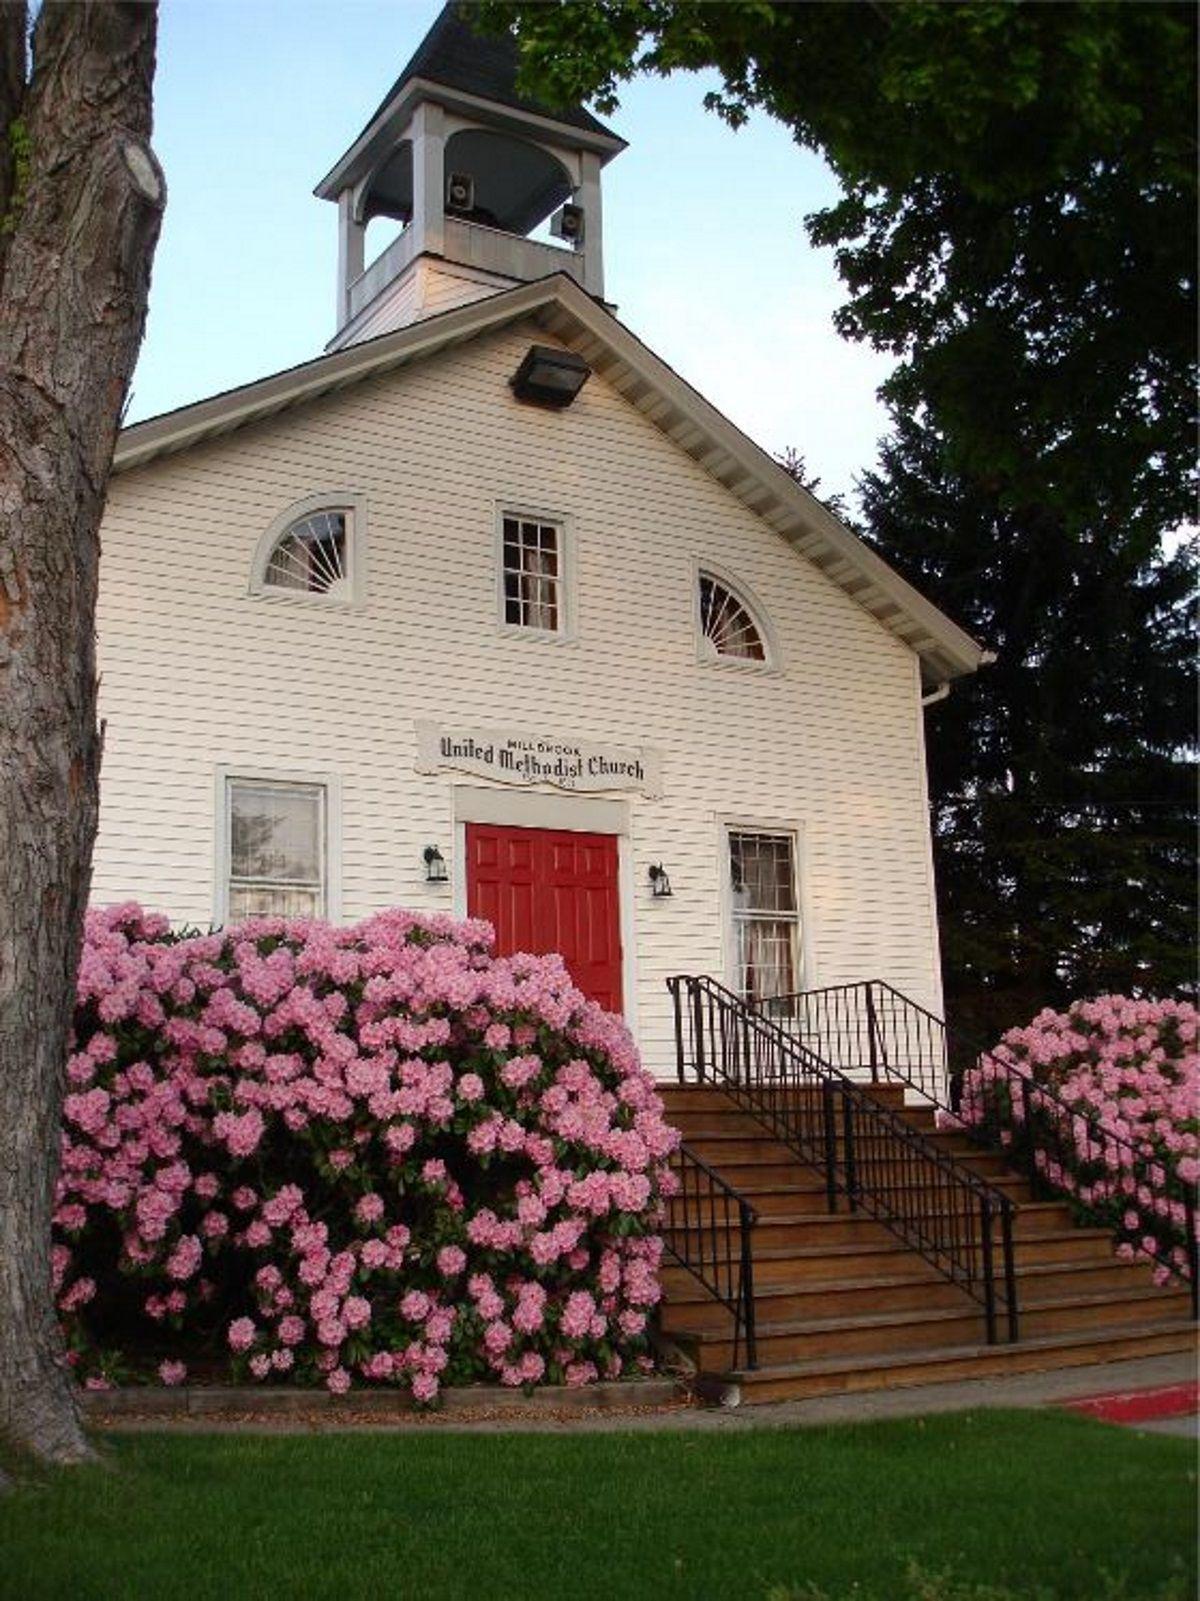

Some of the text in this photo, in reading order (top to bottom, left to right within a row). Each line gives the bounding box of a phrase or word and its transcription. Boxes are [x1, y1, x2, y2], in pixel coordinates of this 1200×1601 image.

[440, 737, 494, 763] United
[498, 749, 583, 777] Methodist
[588, 757, 644, 781] Church
